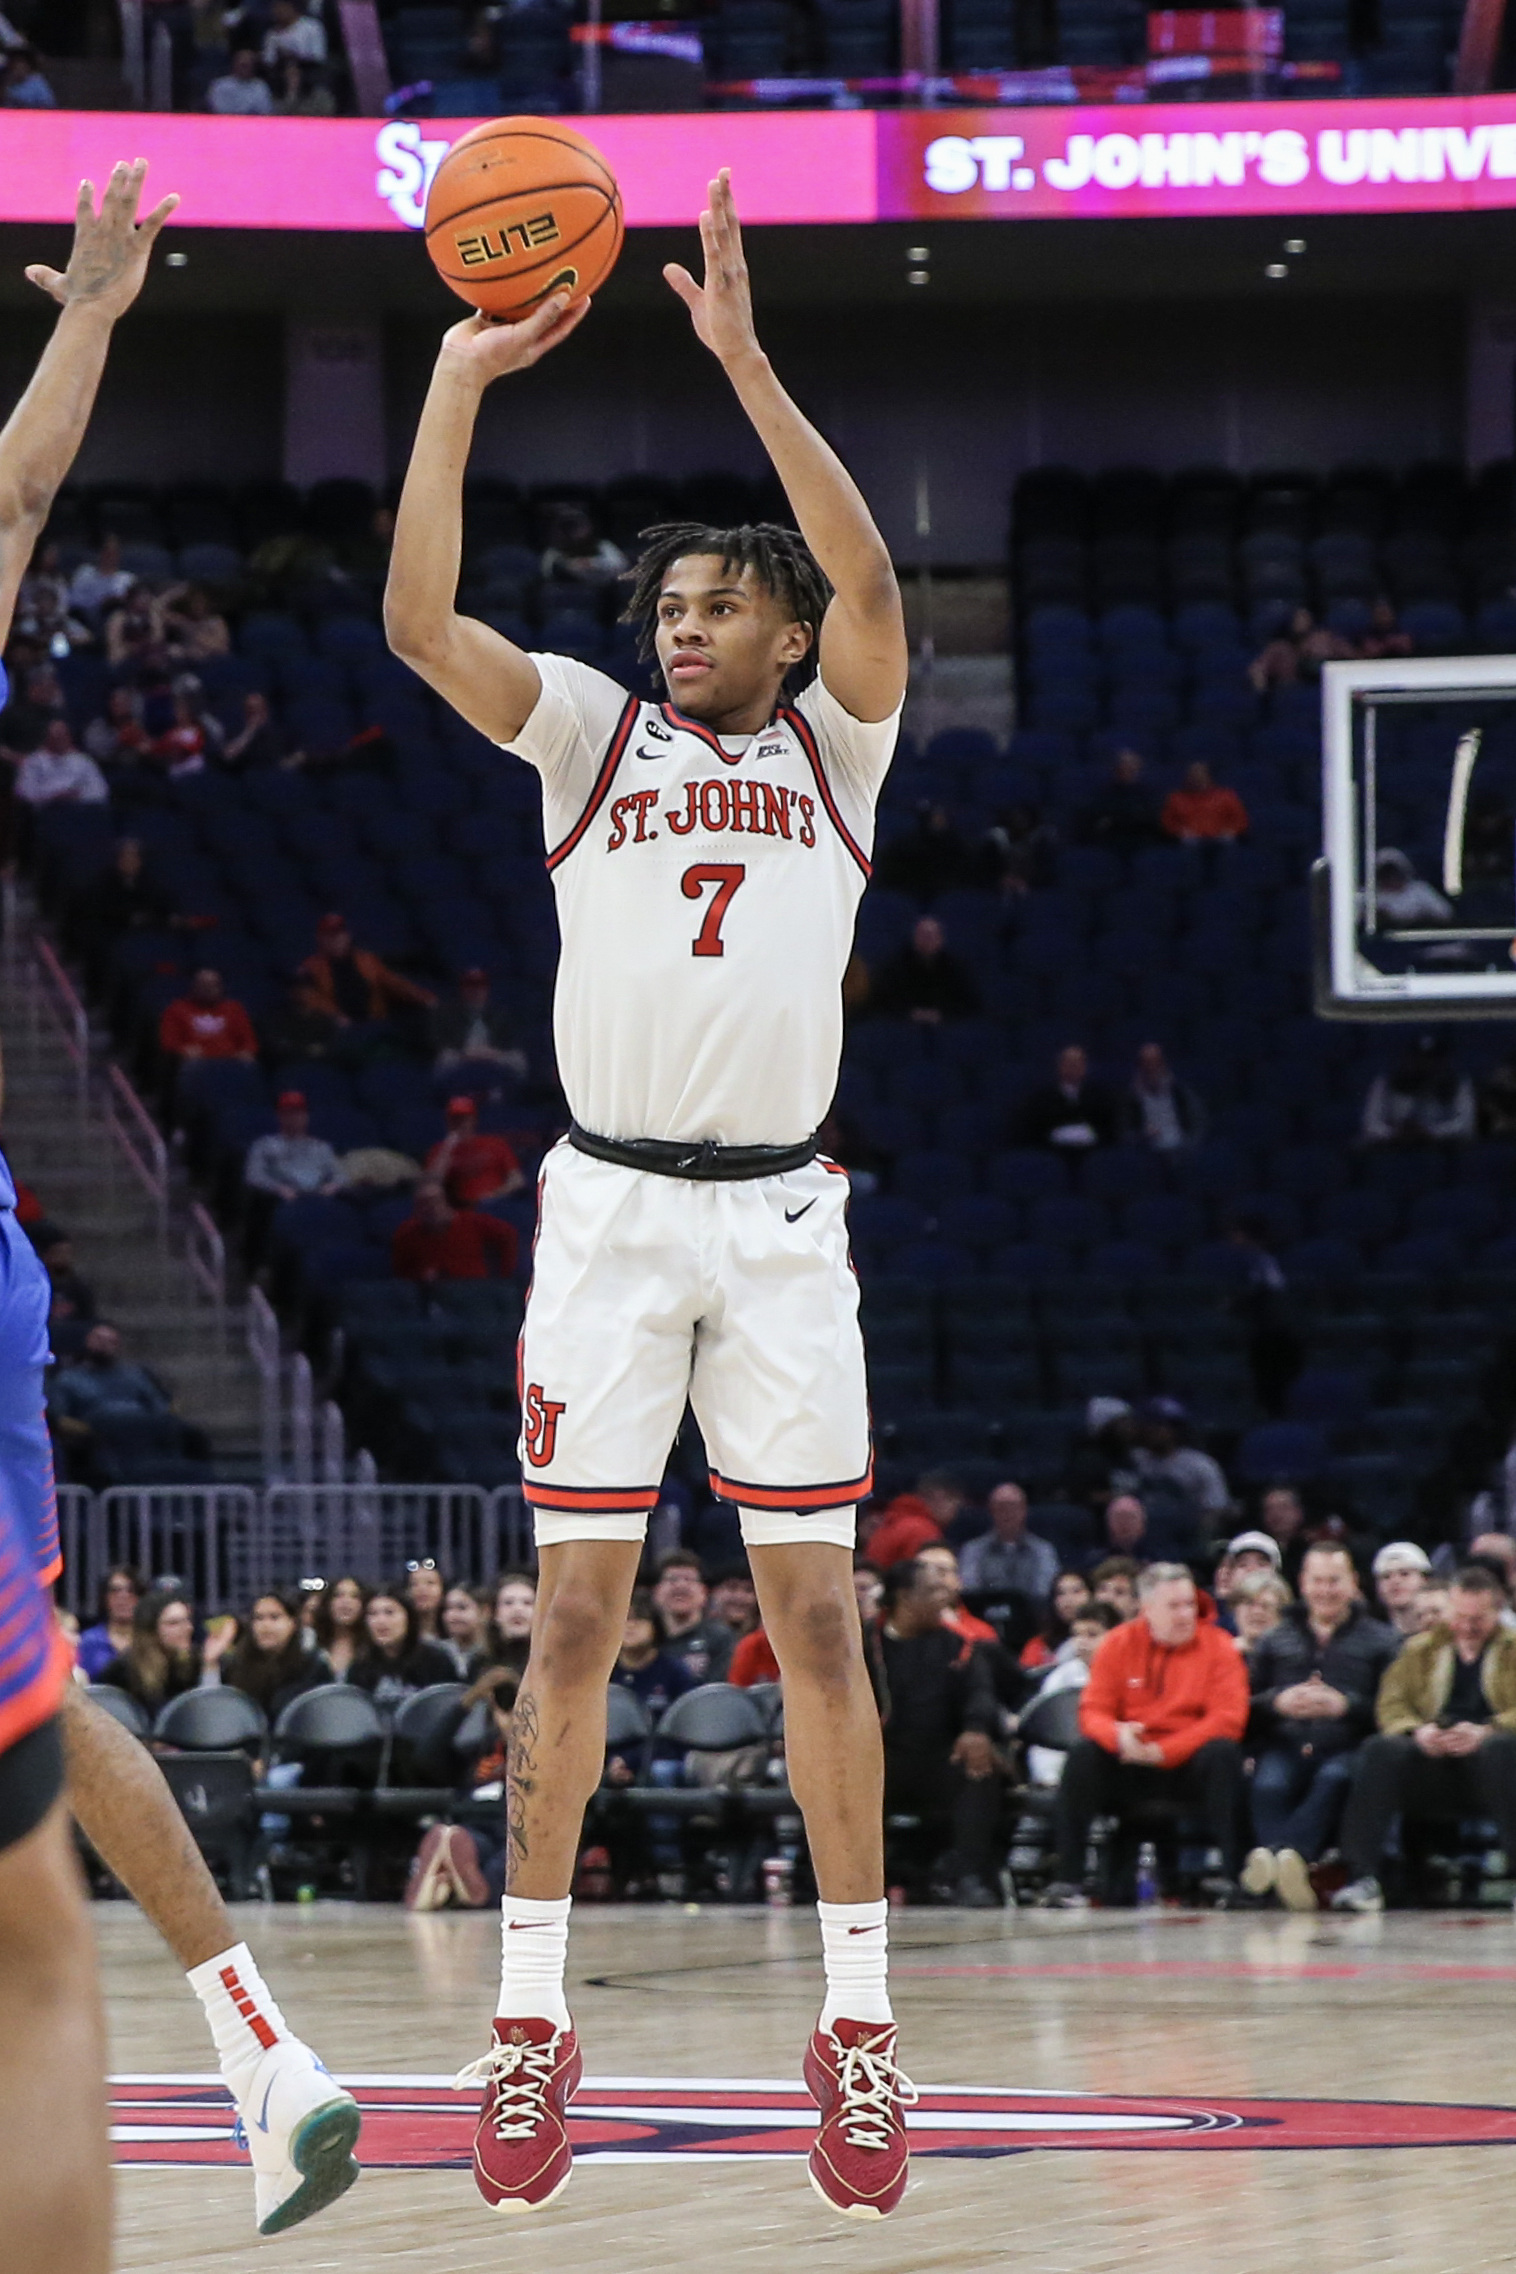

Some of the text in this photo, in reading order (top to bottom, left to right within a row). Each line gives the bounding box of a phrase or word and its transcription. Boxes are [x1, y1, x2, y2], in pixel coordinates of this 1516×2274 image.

[925, 135, 1035, 193] ST.
[1043, 129, 1309, 190] JOHN'S
[456, 210, 561, 268] ELITE
[607, 779, 817, 853] ST. JOHN'S
[680, 863, 746, 957] 7
